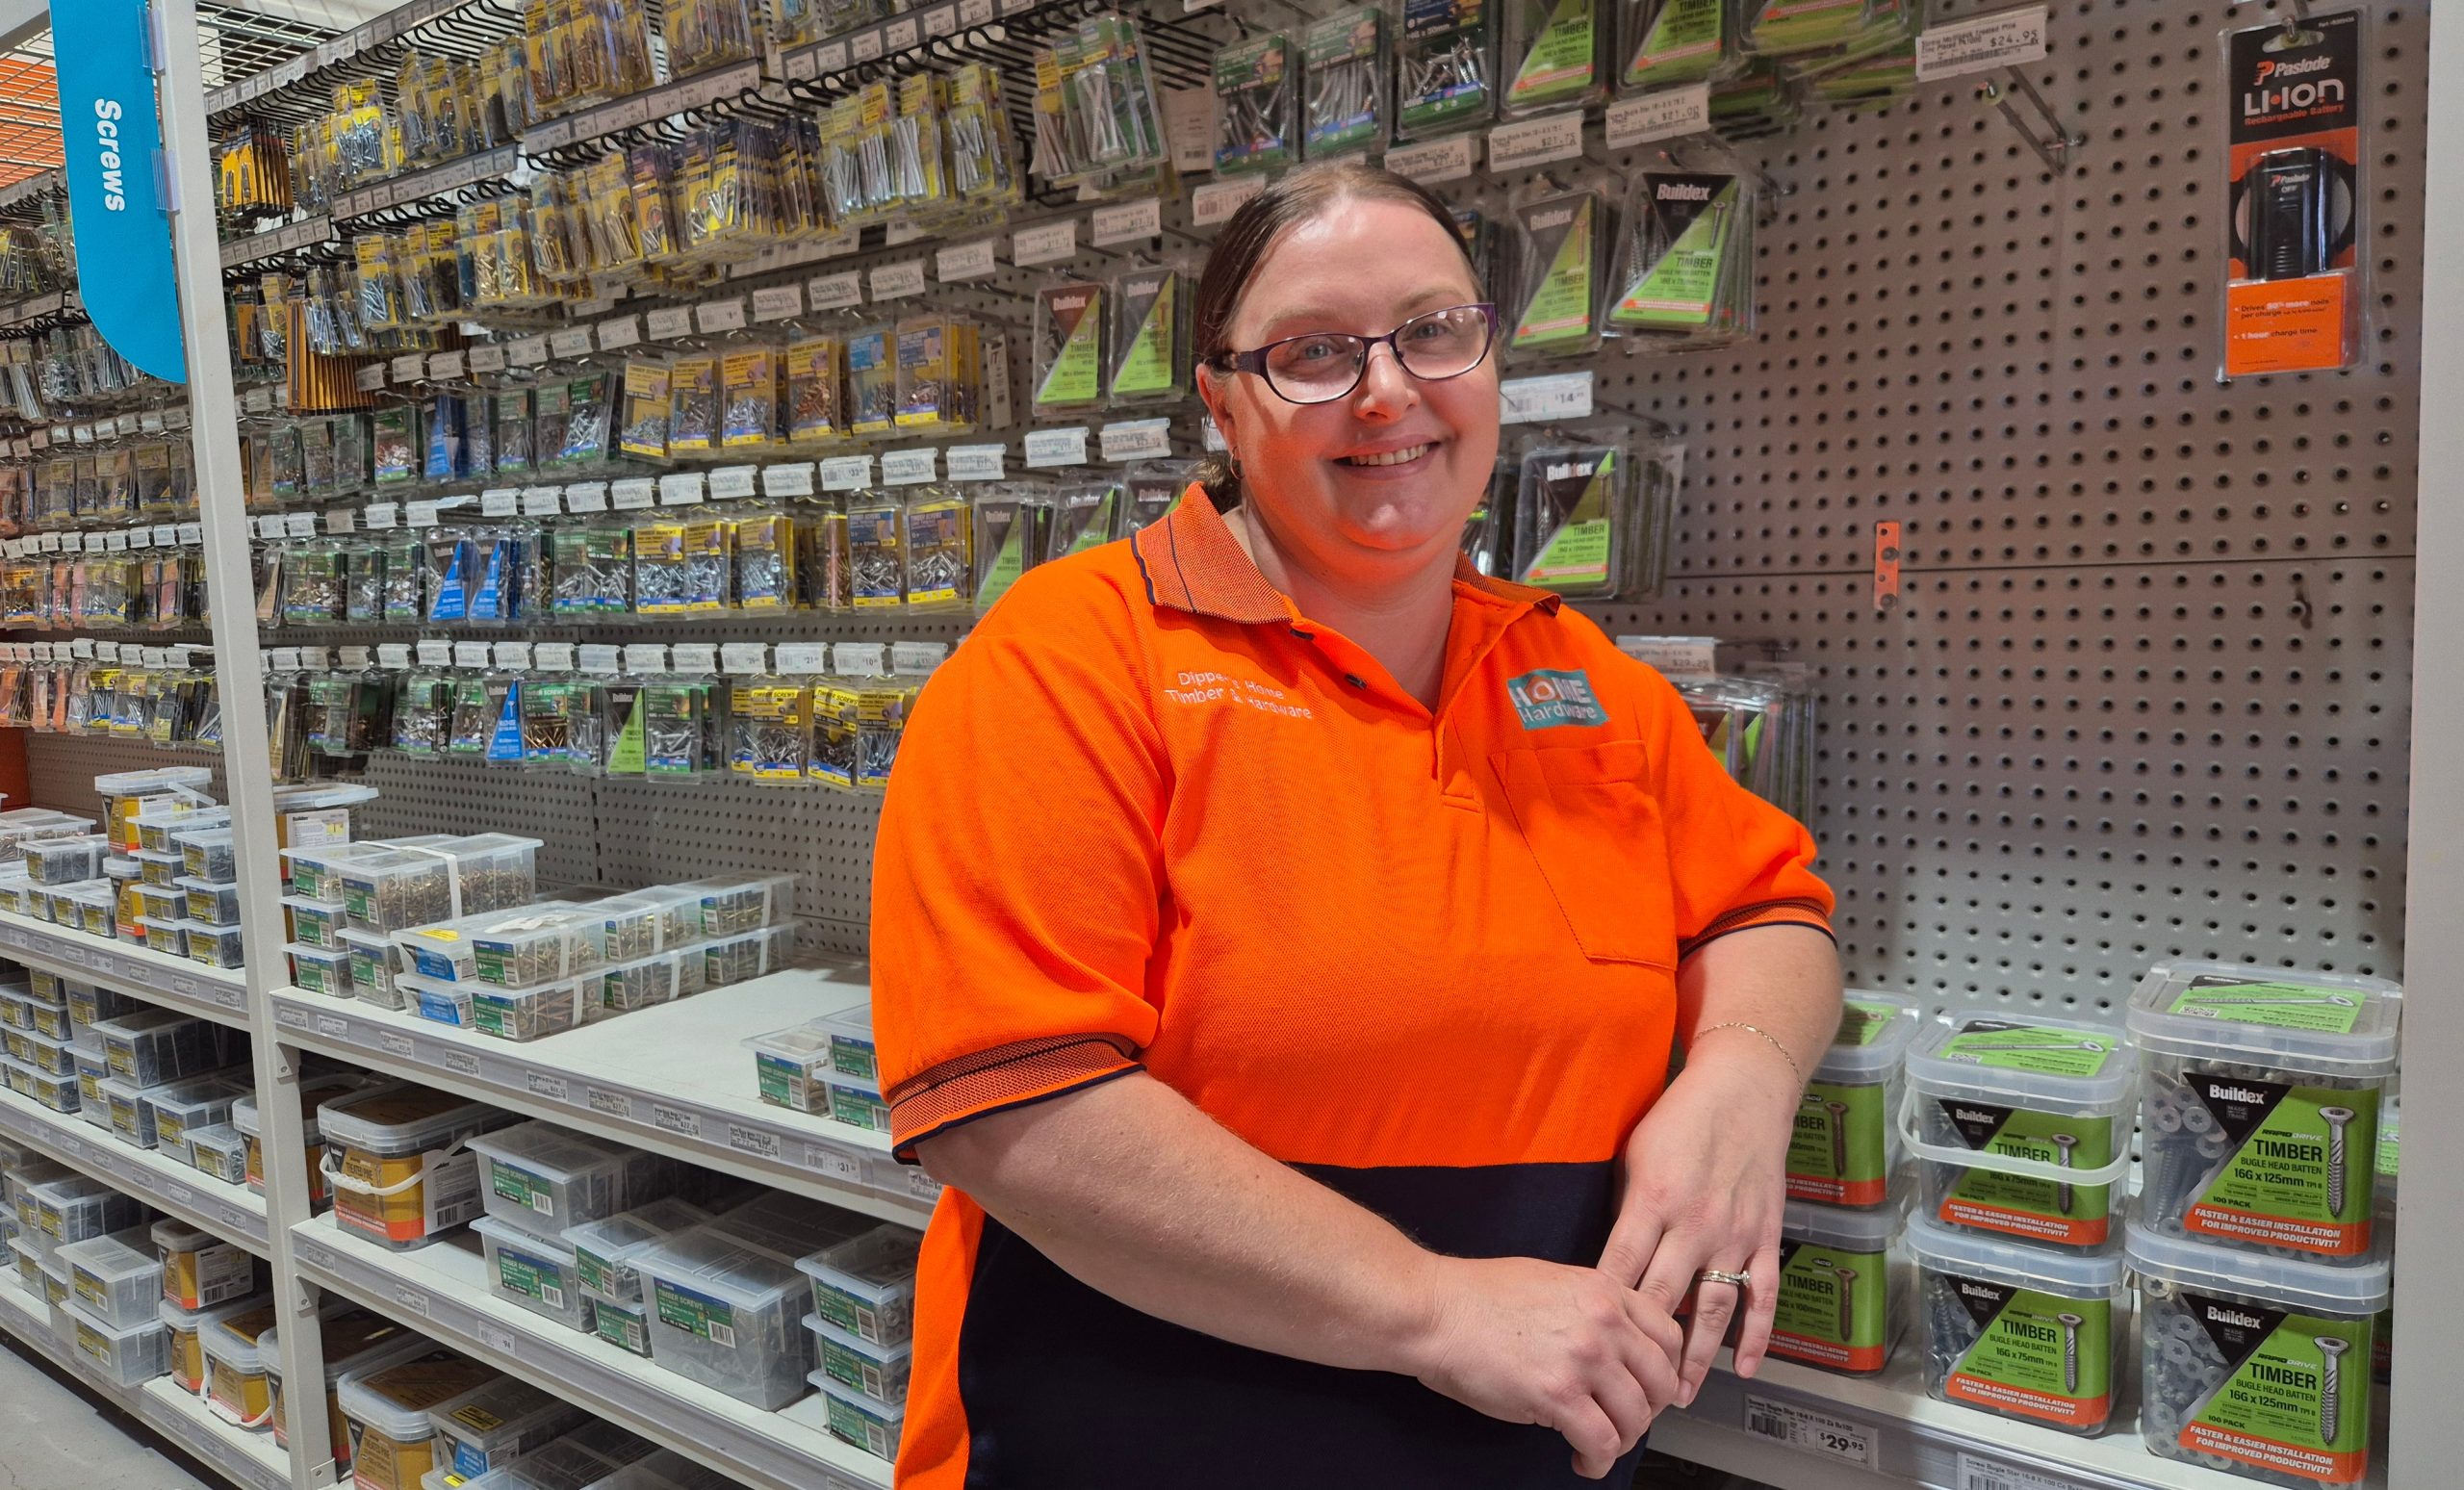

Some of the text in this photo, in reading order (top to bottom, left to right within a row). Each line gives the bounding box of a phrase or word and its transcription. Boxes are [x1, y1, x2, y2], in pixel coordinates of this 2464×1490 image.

[2273, 55, 2333, 78] Paslode
[2244, 103, 2345, 127] Rechargeable Battery
[94, 98, 126, 212] Screws
[1656, 183, 1711, 201] Buildex
[1530, 208, 1573, 231] Buildex
[1677, 257, 1714, 269] TIMBER
[1053, 295, 1087, 311] Buildex
[2255, 309, 2282, 318] charge
[1547, 462, 1594, 481] Buildex
[1574, 525, 1605, 537] TIMBER
[1245, 680, 1284, 700] Home
[1508, 677, 1592, 708] HOME
[1165, 687, 1224, 704] Timber
[1246, 695, 1313, 720] Hardware
[1518, 701, 1598, 724] Hardware
[2209, 1084, 2266, 1105] Buildex
[1793, 1115, 1827, 1131] MBER
[1955, 1108, 1995, 1125] Buildex
[1994, 1142, 2051, 1163] TIMBER
[2253, 1139, 2323, 1163] TIMBER
[2240, 1157, 2323, 1175] BUGLE HEAD BATTEN
[2234, 1168, 2254, 1180] 16G
[2254, 1172, 2263, 1182] x
[2264, 1172, 2305, 1188] 125mm
[2227, 1197, 2251, 1209] PACK
[1948, 1203, 1977, 1216] FASTER
[1985, 1209, 2013, 1222] EASIER
[2013, 1215, 2069, 1231] INSTALLATION
[1954, 1211, 2069, 1239] FOR IMPROVED PRODUCTIVITY
[2194, 1207, 2342, 1239] FASTER & EASIER INSTALLATION
[2201, 1219, 2342, 1248] FOR IMPROVED PRODUCTIVITY
[1784, 1272, 1835, 1296] TIMBER
[1961, 1283, 2001, 1301] Buildex
[2206, 1305, 2262, 1330] Buildex
[2000, 1318, 2058, 1344] TIMBER
[1989, 1333, 2058, 1355] BUGLE HEAD BATTEN
[1995, 1347, 2012, 1359] 16G
[2017, 1350, 2045, 1366] 75mm
[2248, 1361, 2318, 1391] TIMBER
[1955, 1376, 2076, 1409] FASTER & EASIER INSTALLATION
[1962, 1385, 2076, 1417] FOR IMPROVED PRODUCTIVITY
[2228, 1388, 2249, 1403] 16G
[2249, 1396, 2258, 1404] x
[2258, 1395, 2298, 1414] 125mm
[2299, 1406, 2311, 1416] TPI
[2236, 1378, 2317, 1403] BUGLE HEAD BATTEN
[2207, 1414, 2222, 1424] 100
[2222, 1417, 2246, 1430] PACK
[1819, 1431, 1864, 1452] $29.95
[2190, 1425, 2224, 1441] FASTER
[2223, 1432, 2233, 1442] &
[2232, 1434, 2267, 1451] EASIER
[2267, 1442, 2333, 1466] INSTALLATION
[1965, 1457, 1986, 1469] Screw
[1986, 1462, 2006, 1475] Bugle
[2006, 1467, 2020, 1477] Star
[2195, 1436, 2333, 1476] FOR IMPROVED PRODUCTIVITY
